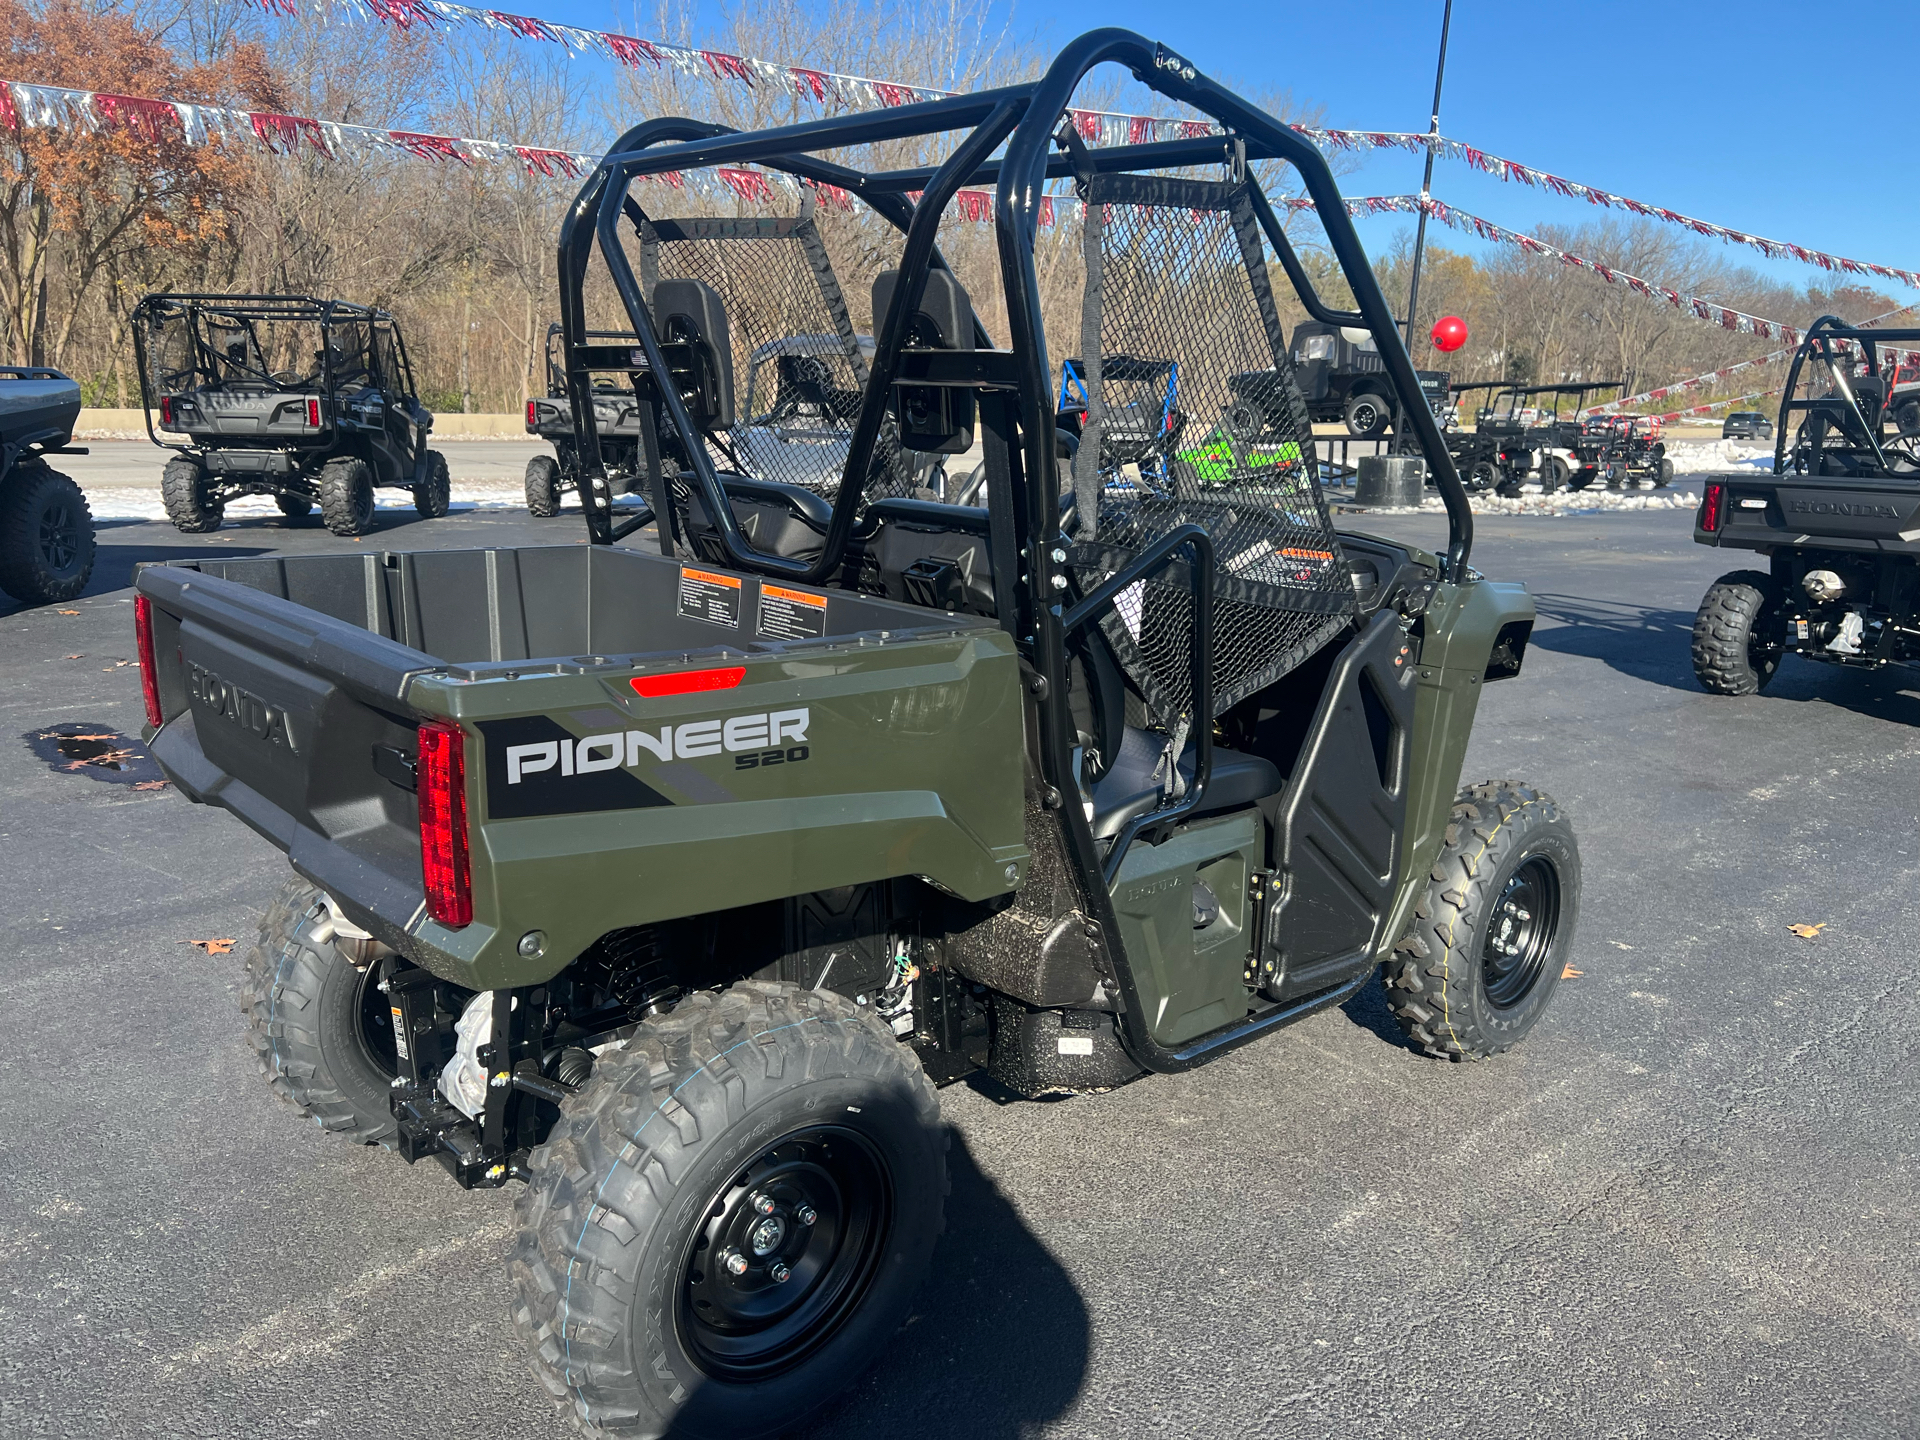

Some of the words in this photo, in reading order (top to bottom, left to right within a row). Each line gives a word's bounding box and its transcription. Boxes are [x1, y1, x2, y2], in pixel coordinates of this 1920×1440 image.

[351, 404, 383, 415] PIONEER
[1789, 500, 1901, 519] HONDA
[702, 572, 724, 584] WARNING
[785, 590, 806, 602] WARNING
[184, 658, 299, 757] HONDA
[506, 707, 810, 784] PIONEER
[734, 745, 810, 771] 520
[1128, 874, 1186, 902] HONDA
